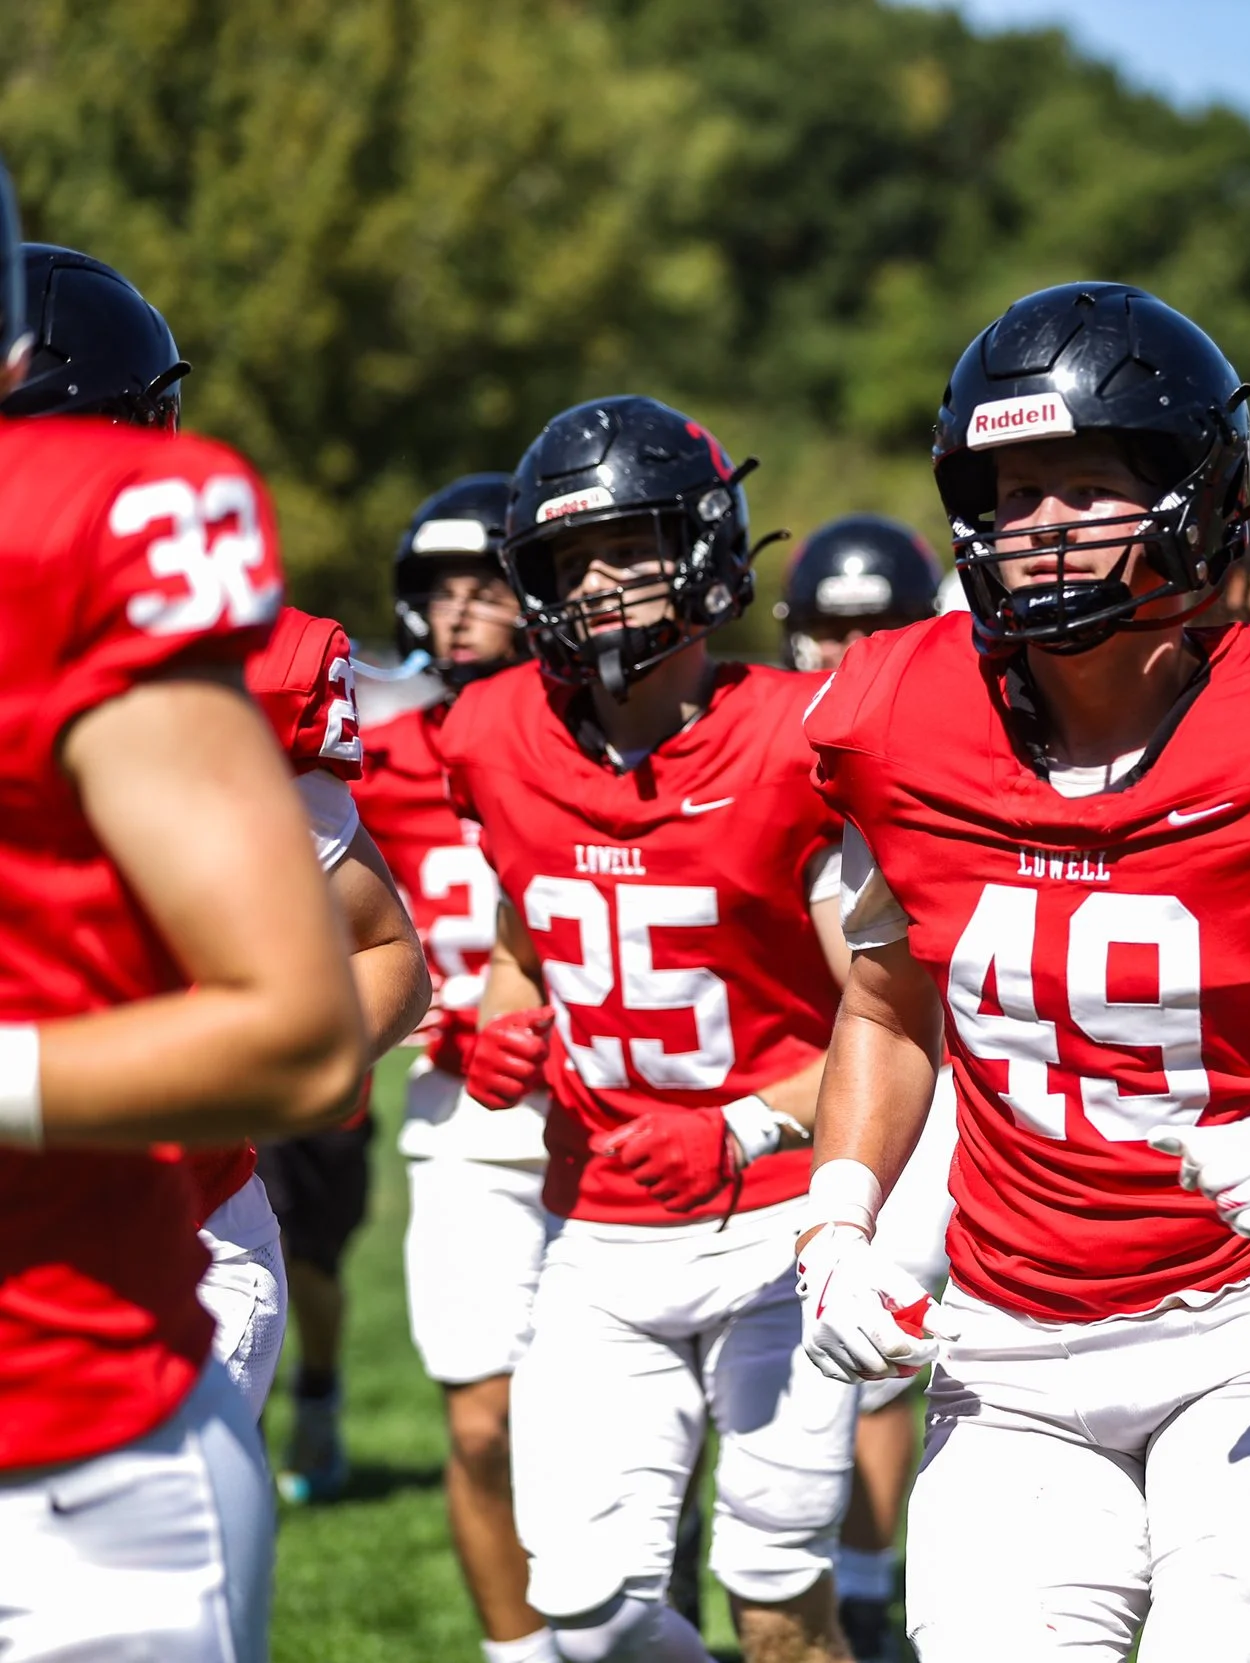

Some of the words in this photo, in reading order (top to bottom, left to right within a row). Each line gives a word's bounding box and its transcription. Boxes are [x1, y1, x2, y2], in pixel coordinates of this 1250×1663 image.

[976, 404, 1056, 433] Riddell
[575, 845, 647, 876] LOWELL
[1017, 847, 1110, 881] LOWELL
[523, 875, 735, 1090] 25
[947, 883, 1210, 1142] 49
